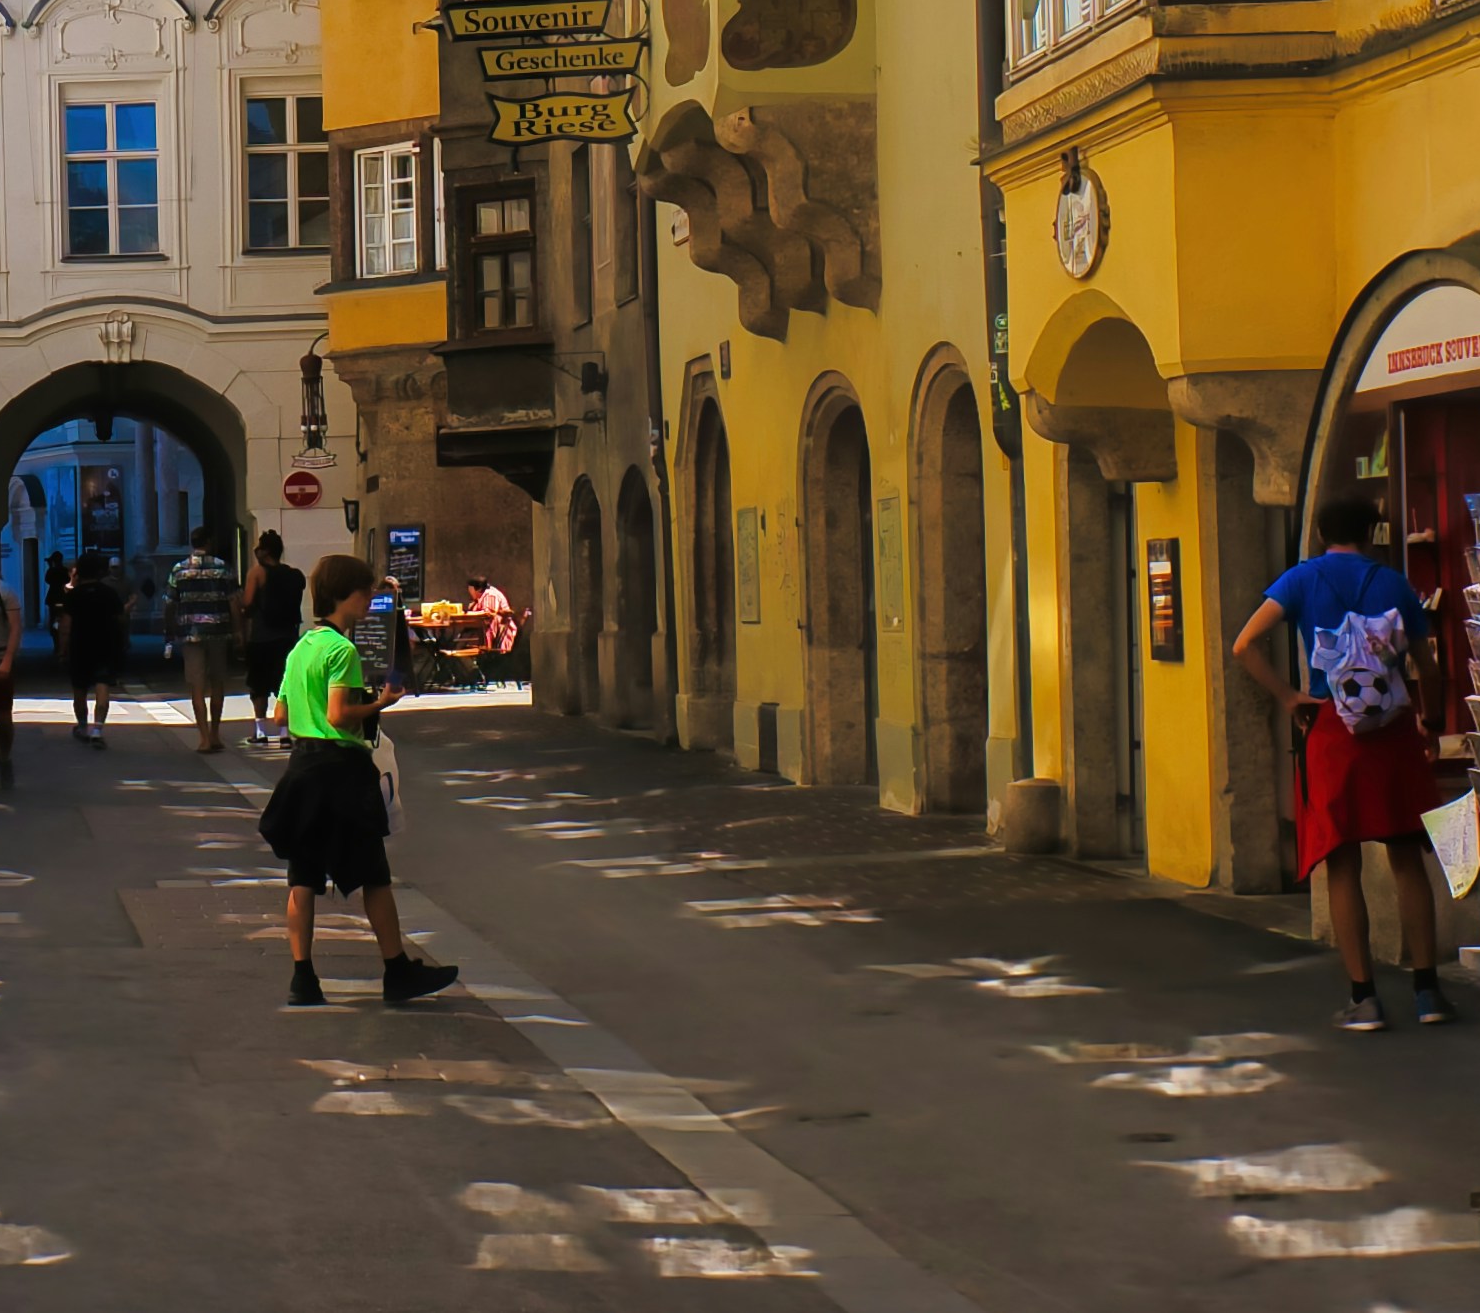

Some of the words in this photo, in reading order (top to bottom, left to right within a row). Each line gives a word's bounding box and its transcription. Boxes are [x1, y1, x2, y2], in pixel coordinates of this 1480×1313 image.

[464, 5, 593, 33] Souvenir
[496, 47, 624, 71] Geschenke
[519, 102, 611, 122] Burg
[513, 119, 617, 137] Riese
[1387, 343, 1443, 374] INNSBRUCK
